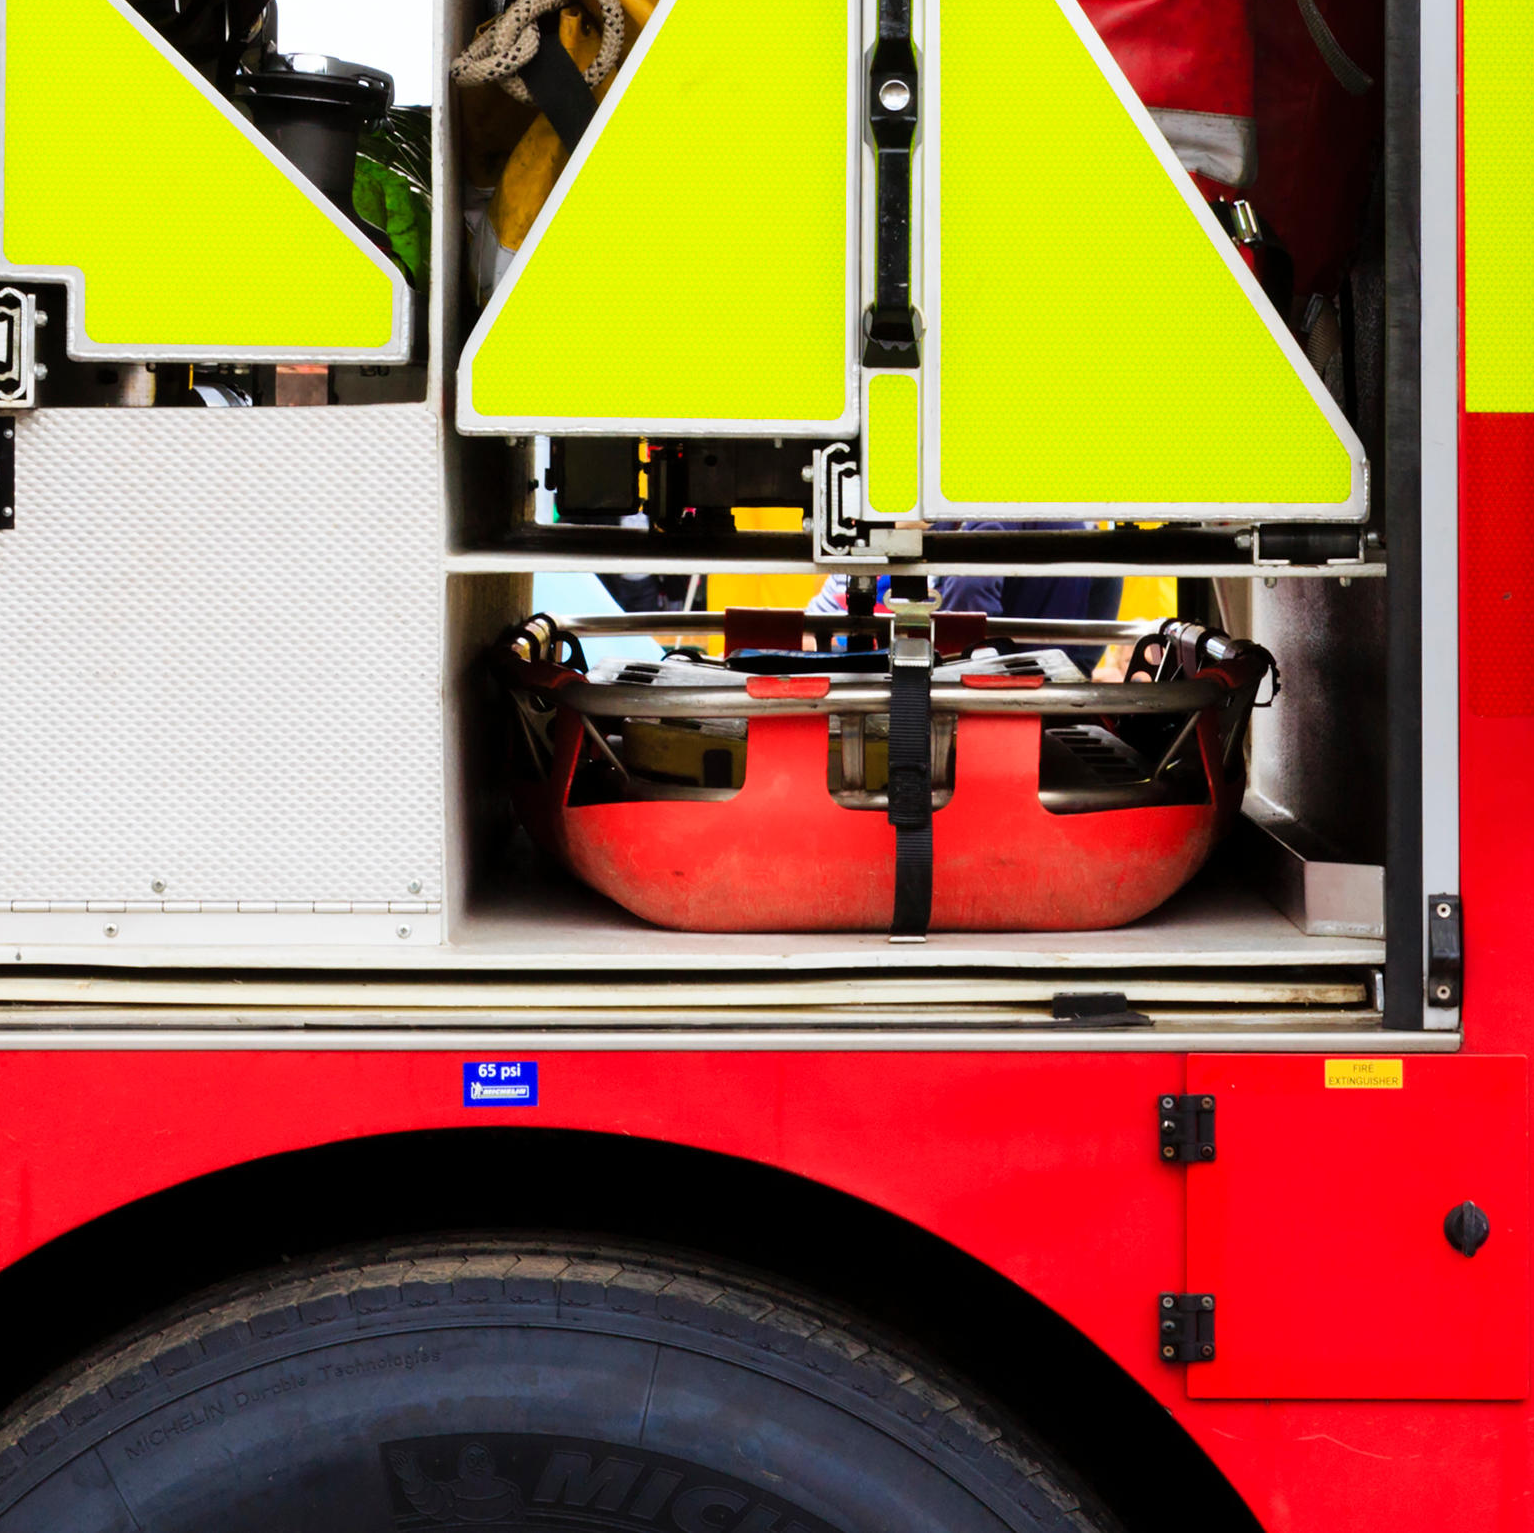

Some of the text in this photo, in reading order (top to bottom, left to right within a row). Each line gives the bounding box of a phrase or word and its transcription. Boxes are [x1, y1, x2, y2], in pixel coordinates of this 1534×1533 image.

[478, 1063, 522, 1081] 65 psi
[1352, 1063, 1375, 1074] FIRE
[1328, 1075, 1399, 1086] EXTINGUISHER
[124, 1346, 443, 1461] MICHELIN Durable Technologies
